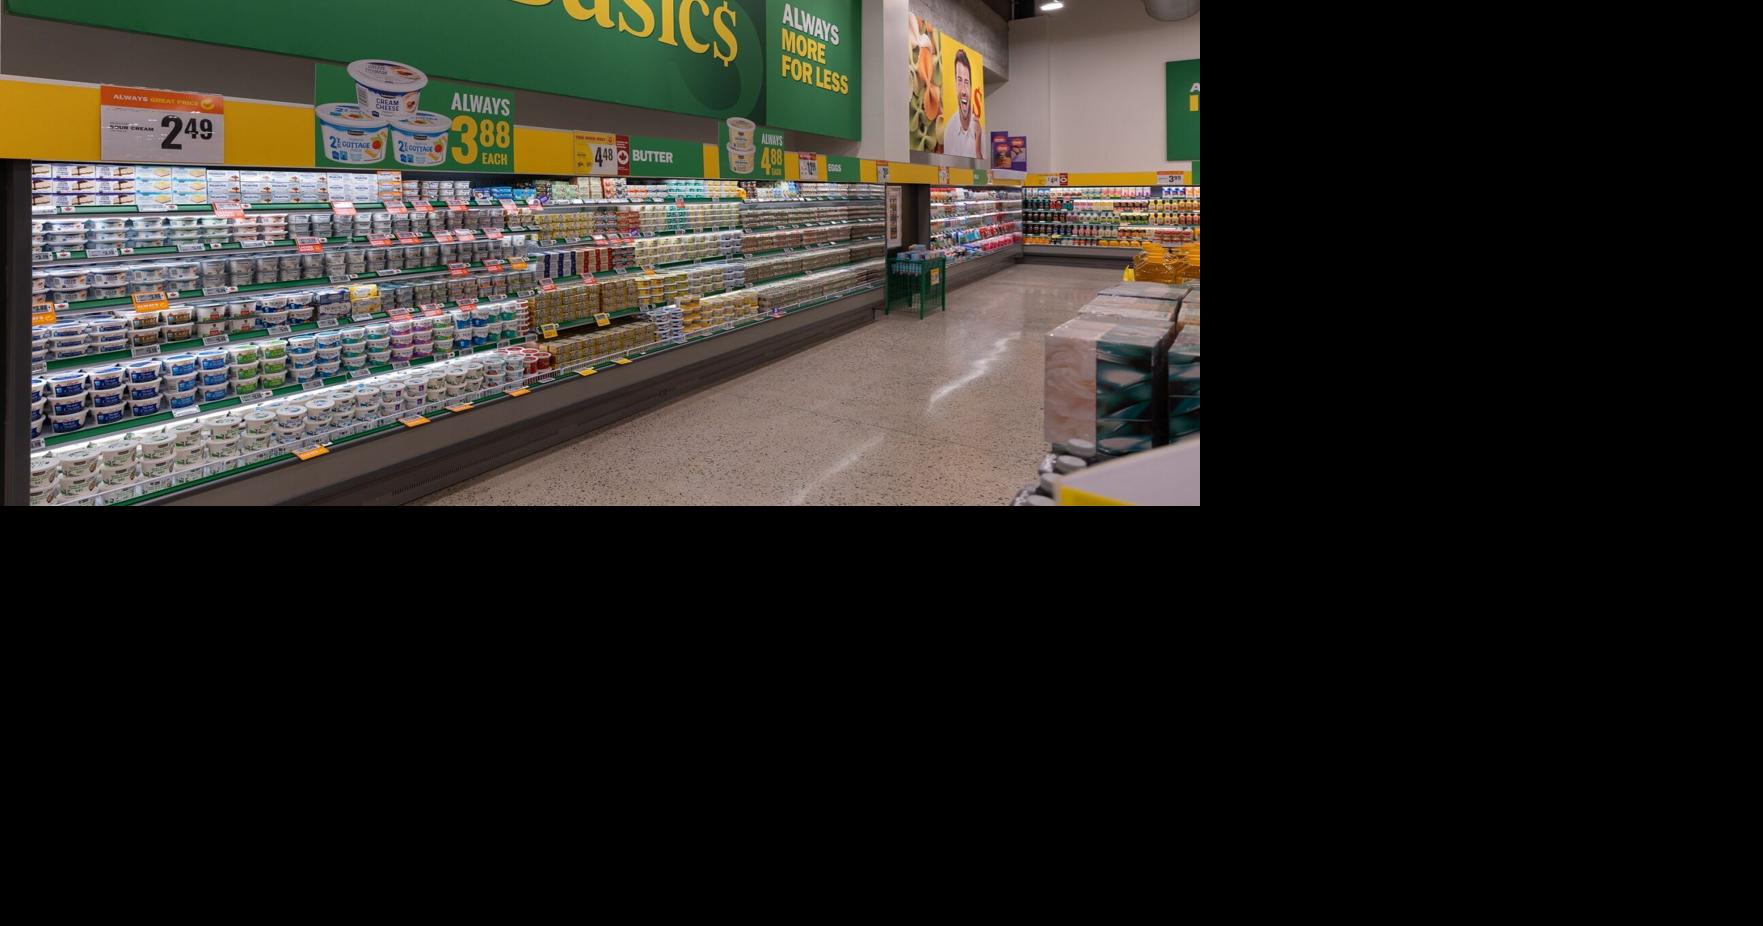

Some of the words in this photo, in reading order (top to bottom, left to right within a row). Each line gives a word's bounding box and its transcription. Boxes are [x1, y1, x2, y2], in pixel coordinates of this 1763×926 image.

[782, 3, 840, 46] ALWAYS
[782, 28, 826, 64] MORE
[782, 54, 813, 85] FOR
[815, 66, 849, 95] LESS
[113, 94, 148, 102] ALWAYS
[376, 97, 399, 106] CREAM
[450, 92, 511, 117] ALWAYS
[375, 103, 399, 112] CHEESE
[761, 133, 783, 146] ALWAYS
[482, 152, 508, 166] EACH
[632, 149, 674, 164] BUTTER
[827, 163, 841, 172] EGGS
